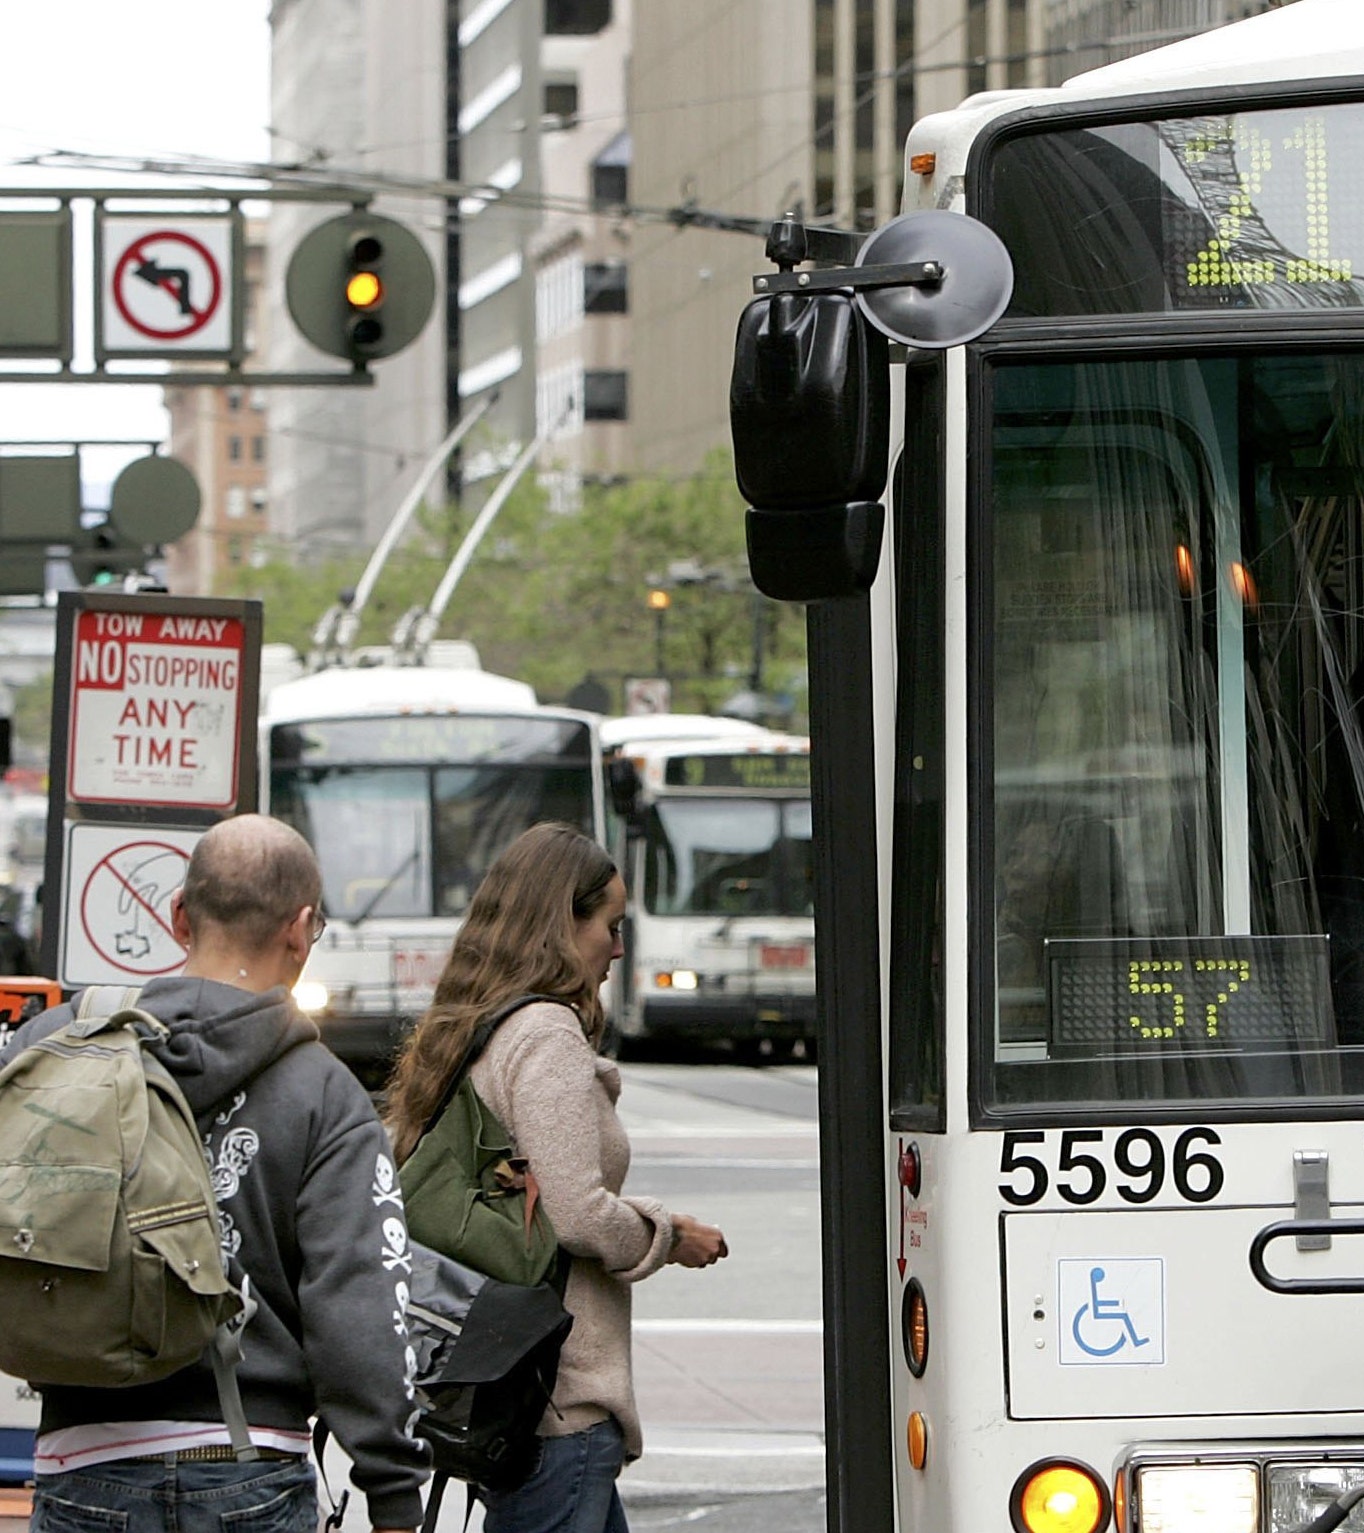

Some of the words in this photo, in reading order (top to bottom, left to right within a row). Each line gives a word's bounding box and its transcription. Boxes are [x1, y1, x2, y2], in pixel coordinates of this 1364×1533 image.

[1184, 116, 1352, 286] 21
[95, 613, 144, 637] TOW
[159, 617, 228, 642] AWAY
[79, 640, 123, 685] NO
[128, 653, 236, 690] STOPPING
[118, 697, 198, 730] ANY
[113, 734, 199, 769] TIME
[1129, 960, 1249, 1038] 57
[998, 1127, 1225, 1207] 5596
